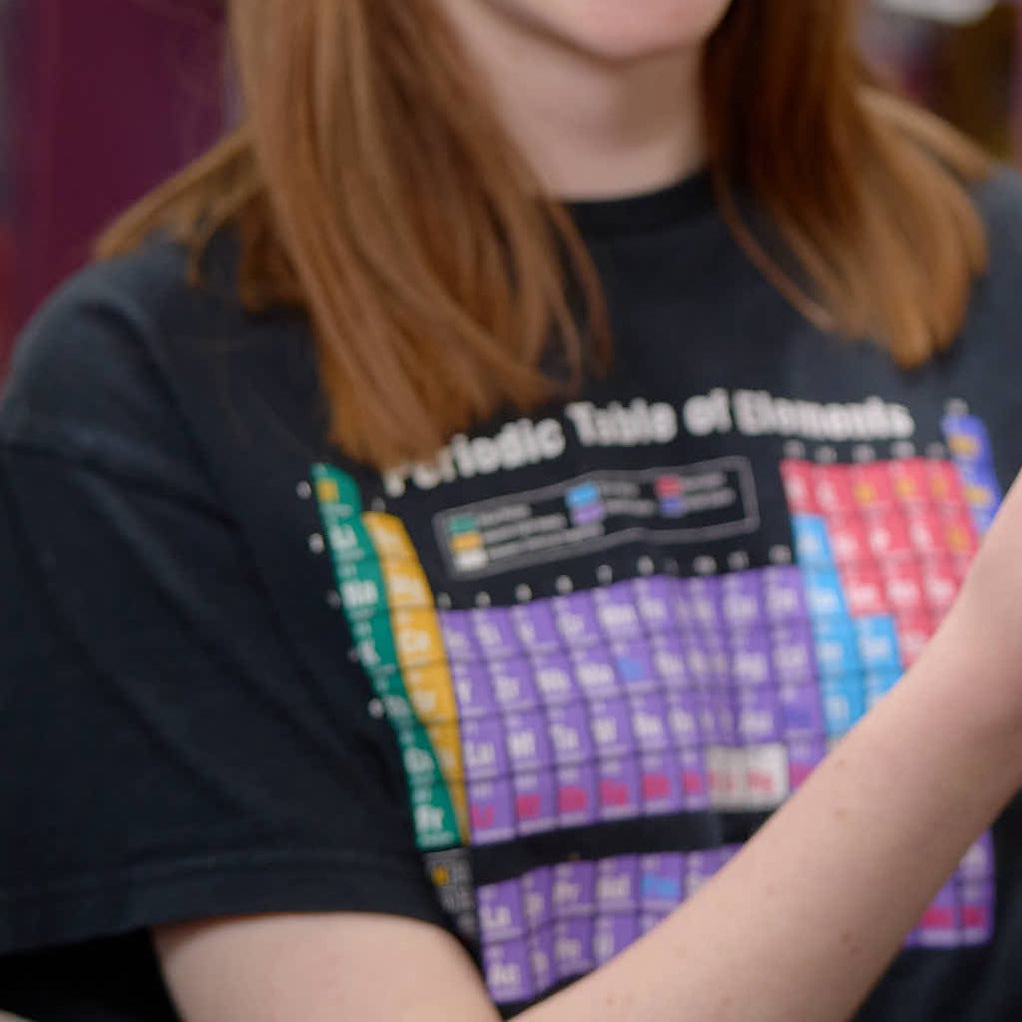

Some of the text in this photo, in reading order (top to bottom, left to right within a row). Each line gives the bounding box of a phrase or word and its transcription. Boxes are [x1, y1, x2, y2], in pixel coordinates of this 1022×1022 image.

[564, 396, 678, 447] Table
[683, 388, 733, 436] of
[732, 388, 915, 441] Elements
